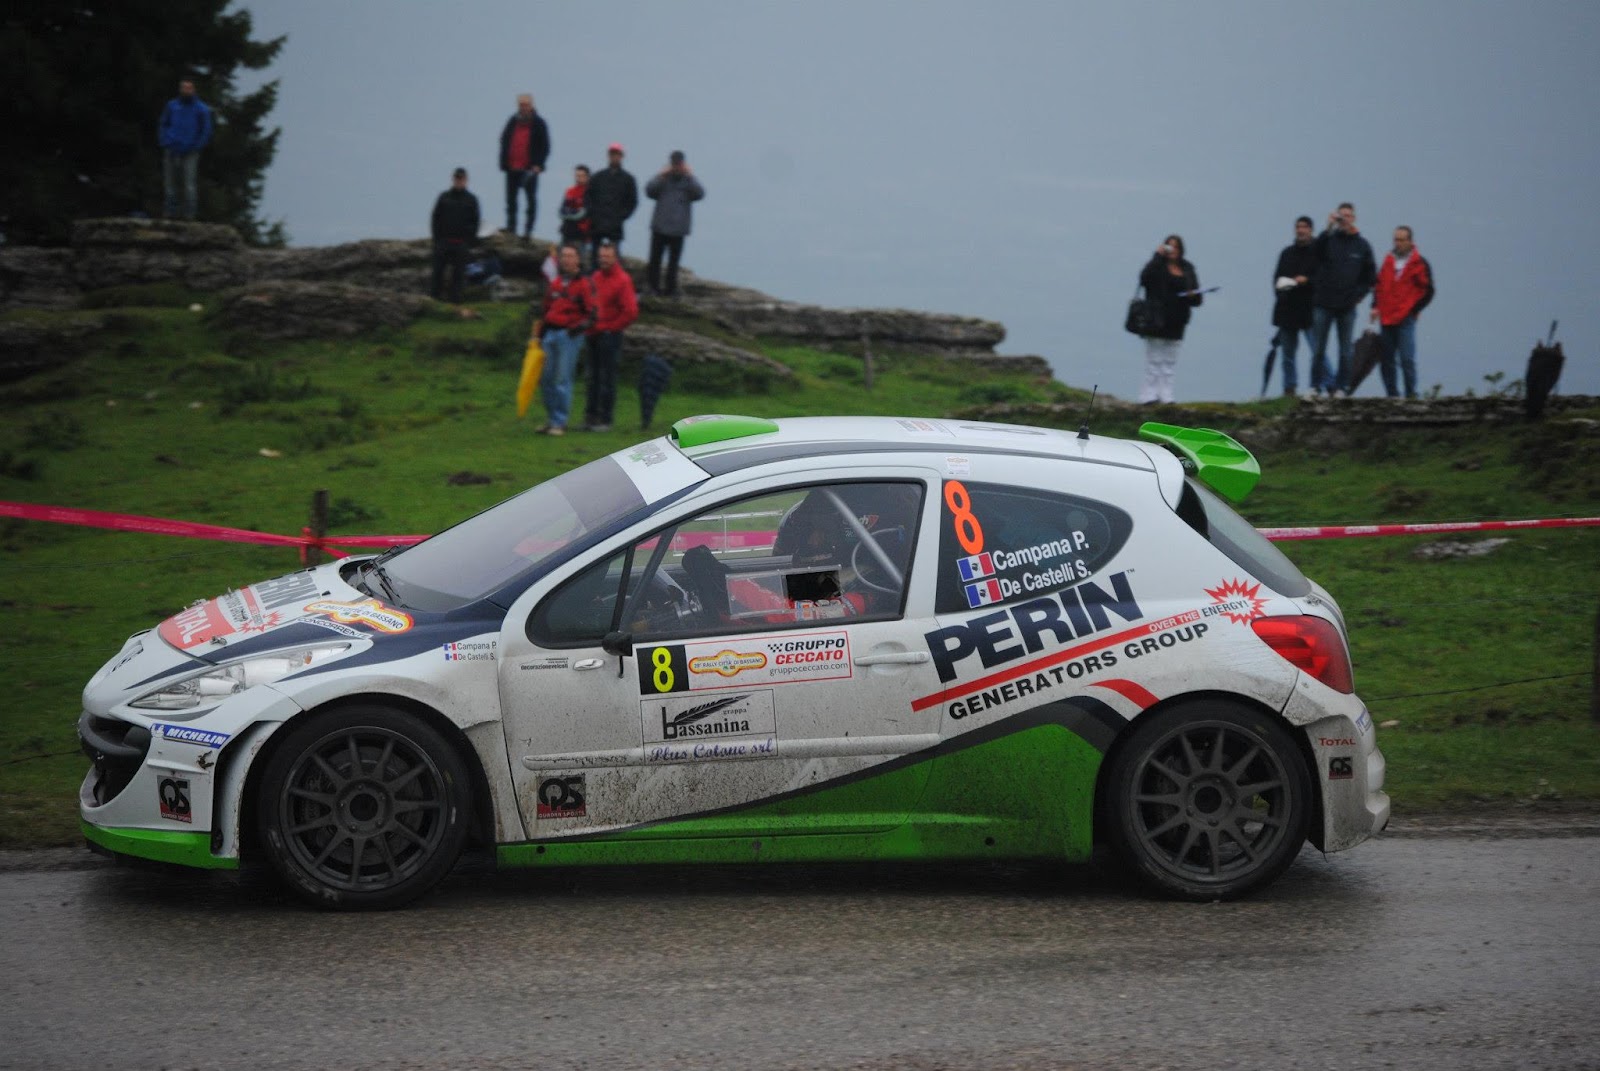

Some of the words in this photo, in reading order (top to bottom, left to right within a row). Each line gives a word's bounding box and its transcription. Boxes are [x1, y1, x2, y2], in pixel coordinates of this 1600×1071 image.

[944, 479, 984, 555] 8
[992, 538, 1072, 570] Campana
[1072, 530, 1090, 551] P.
[1000, 578, 1022, 598] De
[1022, 562, 1076, 592] Castelli
[1075, 559, 1092, 578] S.
[369, 611, 404, 630] BASSANO
[924, 571, 1144, 684] PERIN
[1148, 617, 1178, 633] OVER
[1178, 610, 1200, 624] THE
[1201, 600, 1250, 618] ENERGY!
[457, 642, 490, 651] Campana
[740, 657, 763, 665] BASSANO
[775, 649, 844, 665] CECCATO
[784, 638, 846, 652] GRUPPO
[652, 646, 675, 693] 8
[769, 662, 849, 677] gruppoceccato.com
[949, 650, 1118, 721] GENERATORS
[1124, 623, 1209, 660] GROUP
[661, 705, 750, 739] bassanina
[722, 707, 748, 716] grappa
[166, 728, 226, 746] MICHELIN
[1318, 737, 1356, 747] TOTAL
[159, 778, 190, 815] QS
[539, 776, 585, 811] QS
